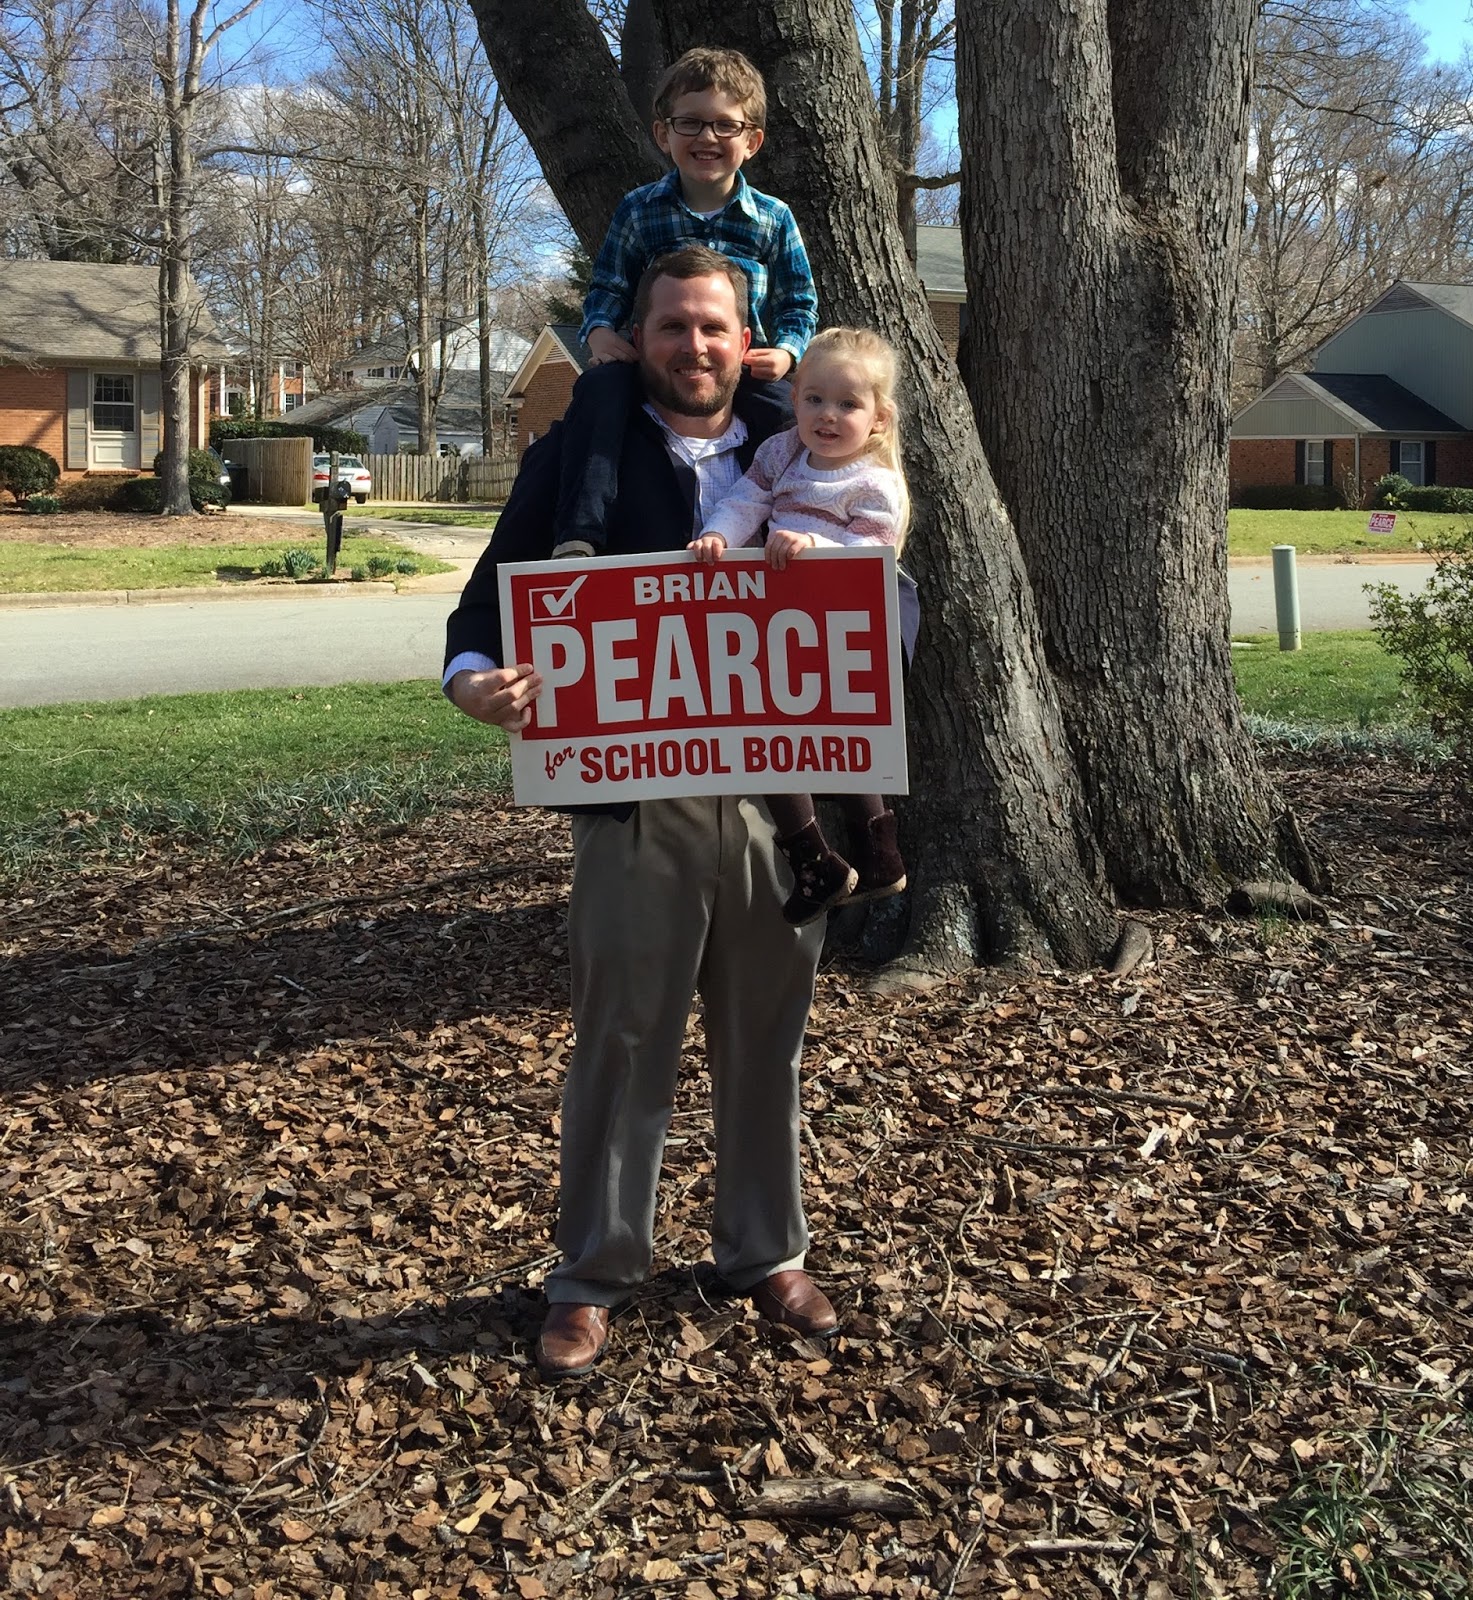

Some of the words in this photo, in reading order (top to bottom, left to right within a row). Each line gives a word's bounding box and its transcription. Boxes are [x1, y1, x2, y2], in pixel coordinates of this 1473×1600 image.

[633, 570, 766, 606] BRIAN
[531, 608, 877, 729] PEARCE
[544, 745, 576, 781] for
[580, 738, 731, 783] SCHOOL
[743, 735, 872, 773] BOARD
